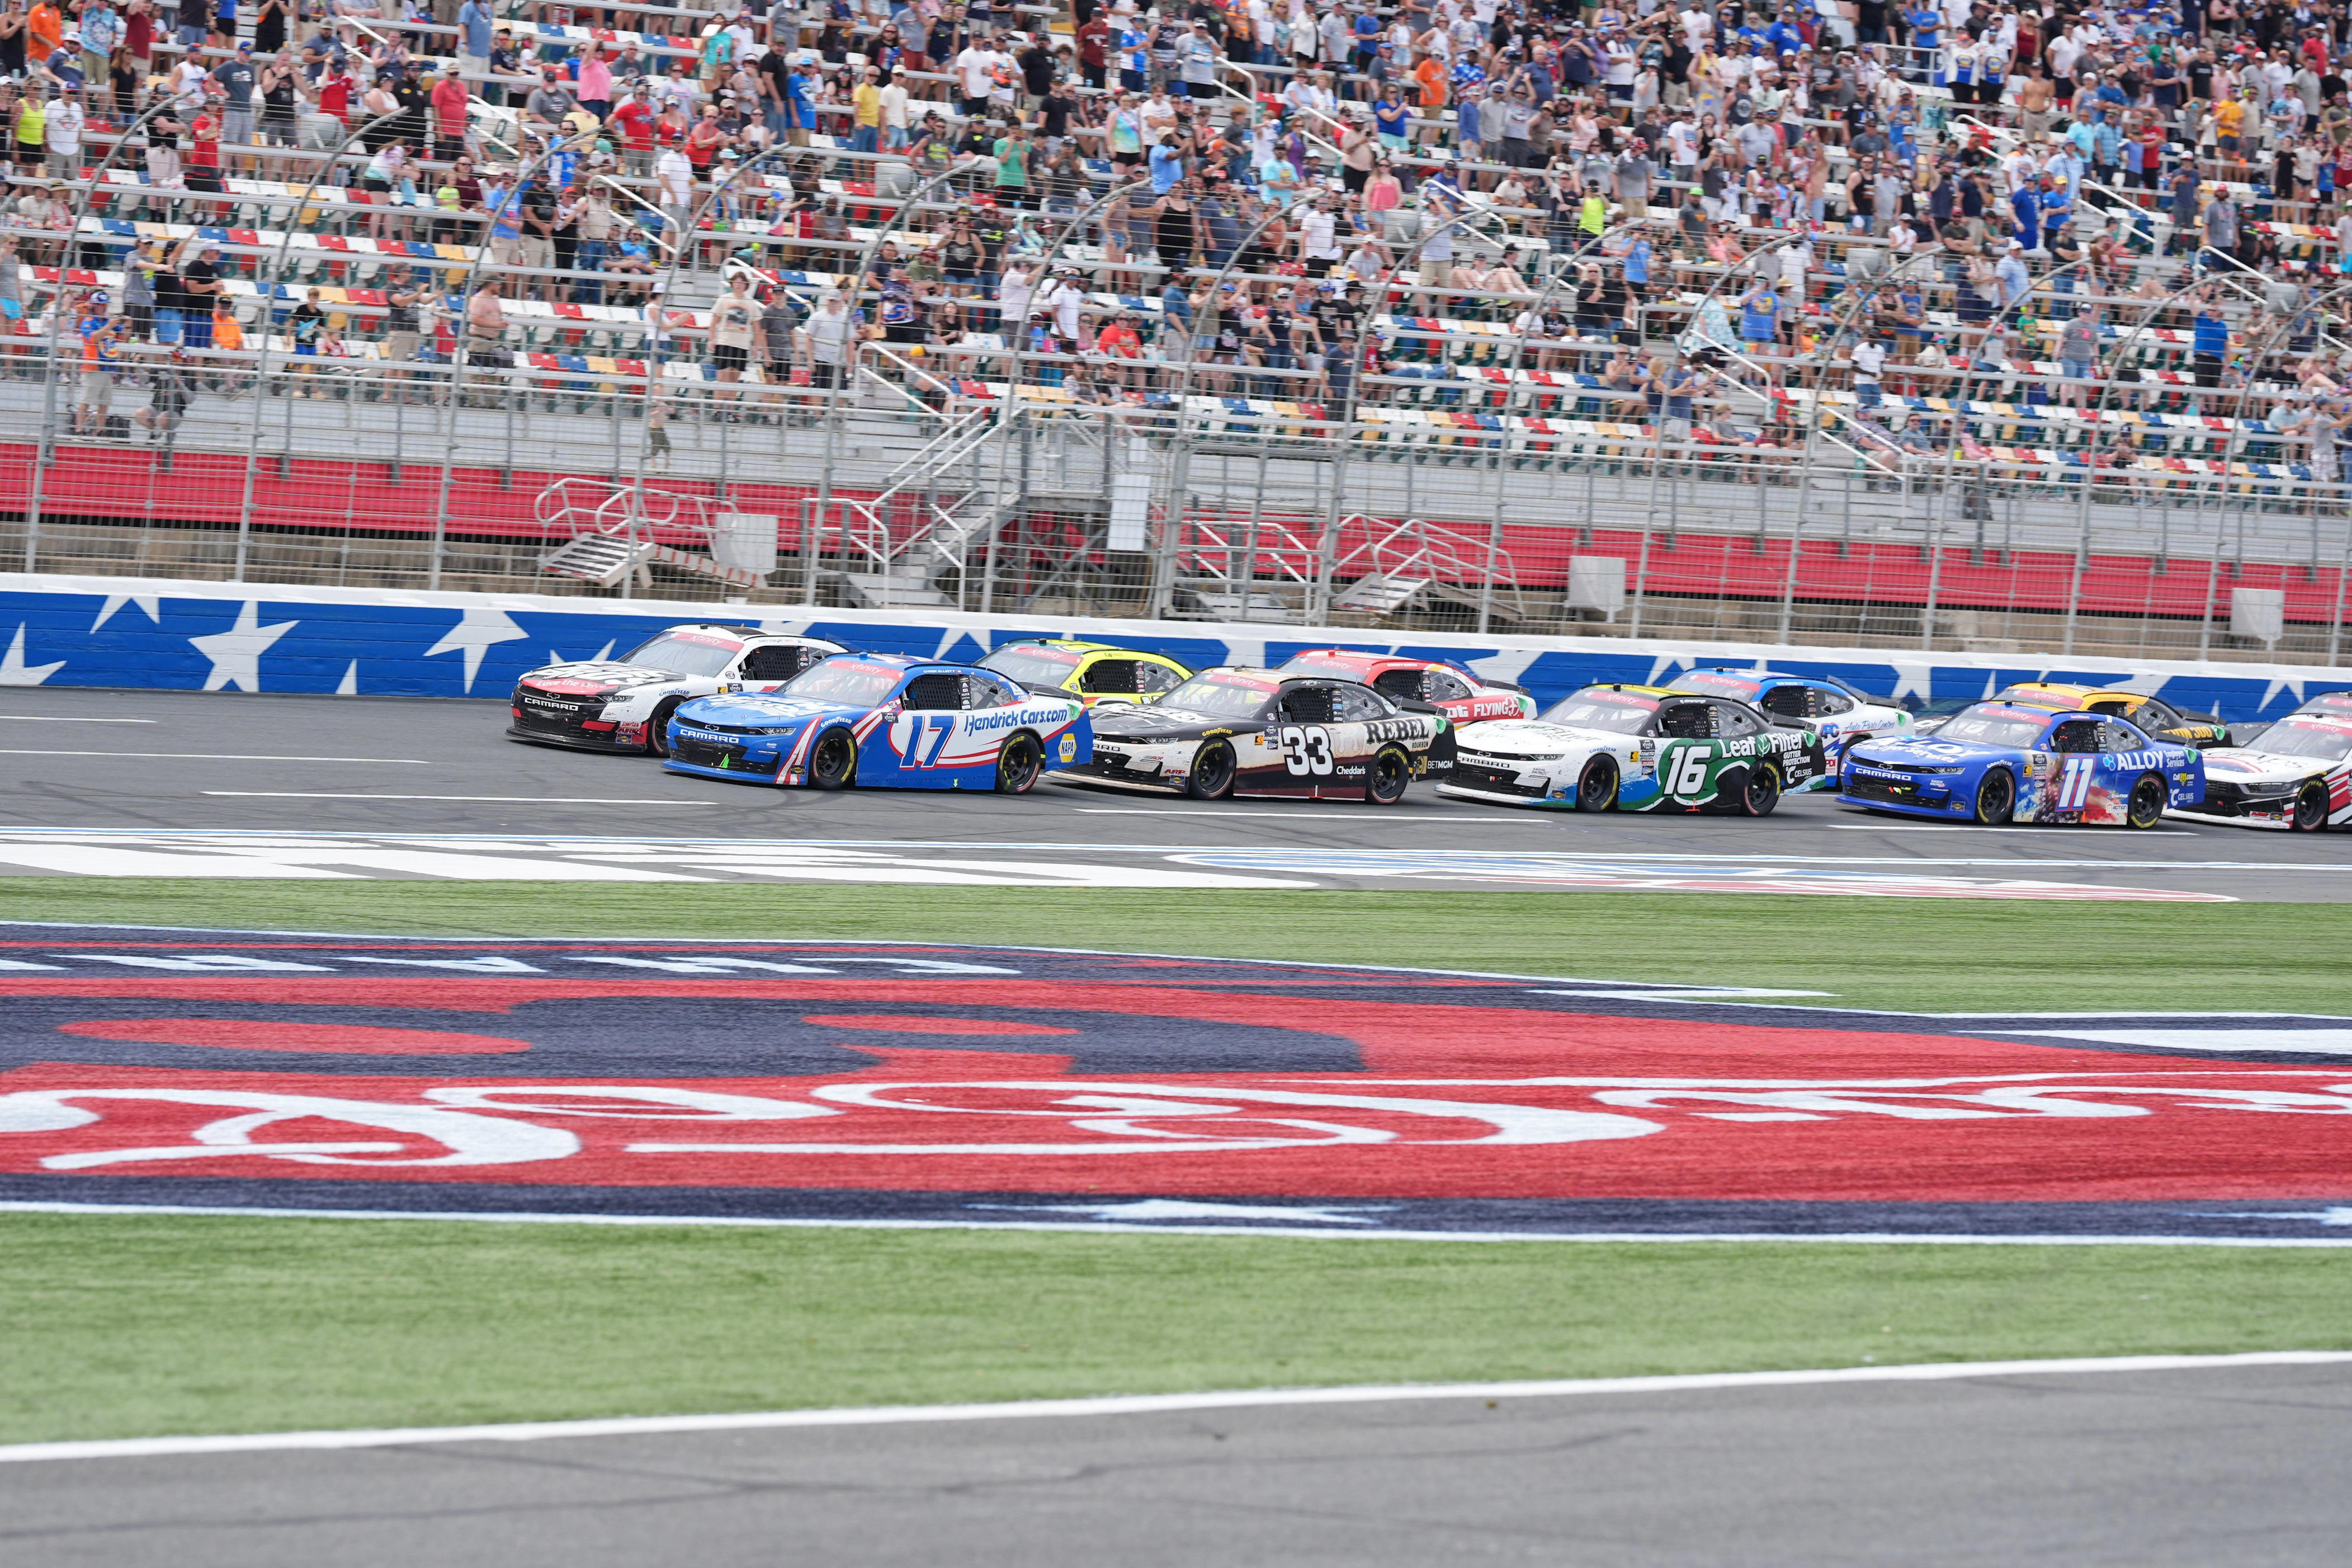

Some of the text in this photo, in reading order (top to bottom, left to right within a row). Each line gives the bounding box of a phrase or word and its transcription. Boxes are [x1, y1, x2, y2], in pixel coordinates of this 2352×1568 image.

[691, 635, 724, 645] xfinity
[1031, 650, 1064, 660] xfinity
[850, 664, 884, 673] xfinity
[1321, 660, 1353, 669] xfinity
[1225, 676, 1259, 688] xfinity
[1709, 677, 1742, 686] xfinity
[659, 688, 690, 697] GOODYEAR
[2033, 692, 2064, 701] xfinity
[524, 697, 579, 711] CAMARO
[1606, 693, 1640, 704] xfinity
[1474, 701, 1508, 717] FLYING
[1999, 710, 2033, 720] xfinity
[820, 716, 852, 728] GOODYEAR
[2310, 723, 2342, 731] xfinity
[1202, 728, 1232, 736] GOODYEAR
[1364, 717, 1429, 744] REBEL
[680, 729, 739, 744] CAMARO
[900, 714, 956, 769] 17
[1061, 741, 1074, 754] NAPA
[1717, 733, 1802, 758] Leaf Filter
[1282, 727, 1334, 776] 33
[1783, 750, 1801, 759] GUTTER
[1427, 760, 1453, 769] BETMGM
[1783, 755, 1811, 767] PROTECTION
[1986, 759, 2013, 769] GOODYEAR
[2116, 750, 2163, 771] ALLOY
[2166, 759, 2185, 768] Services
[1336, 764, 1366, 776] Cheddar's
[1664, 745, 1712, 795] 16
[1794, 768, 1812, 777] CELSIUS
[1855, 768, 1911, 781] CAMARO
[2057, 757, 2095, 809] 11
